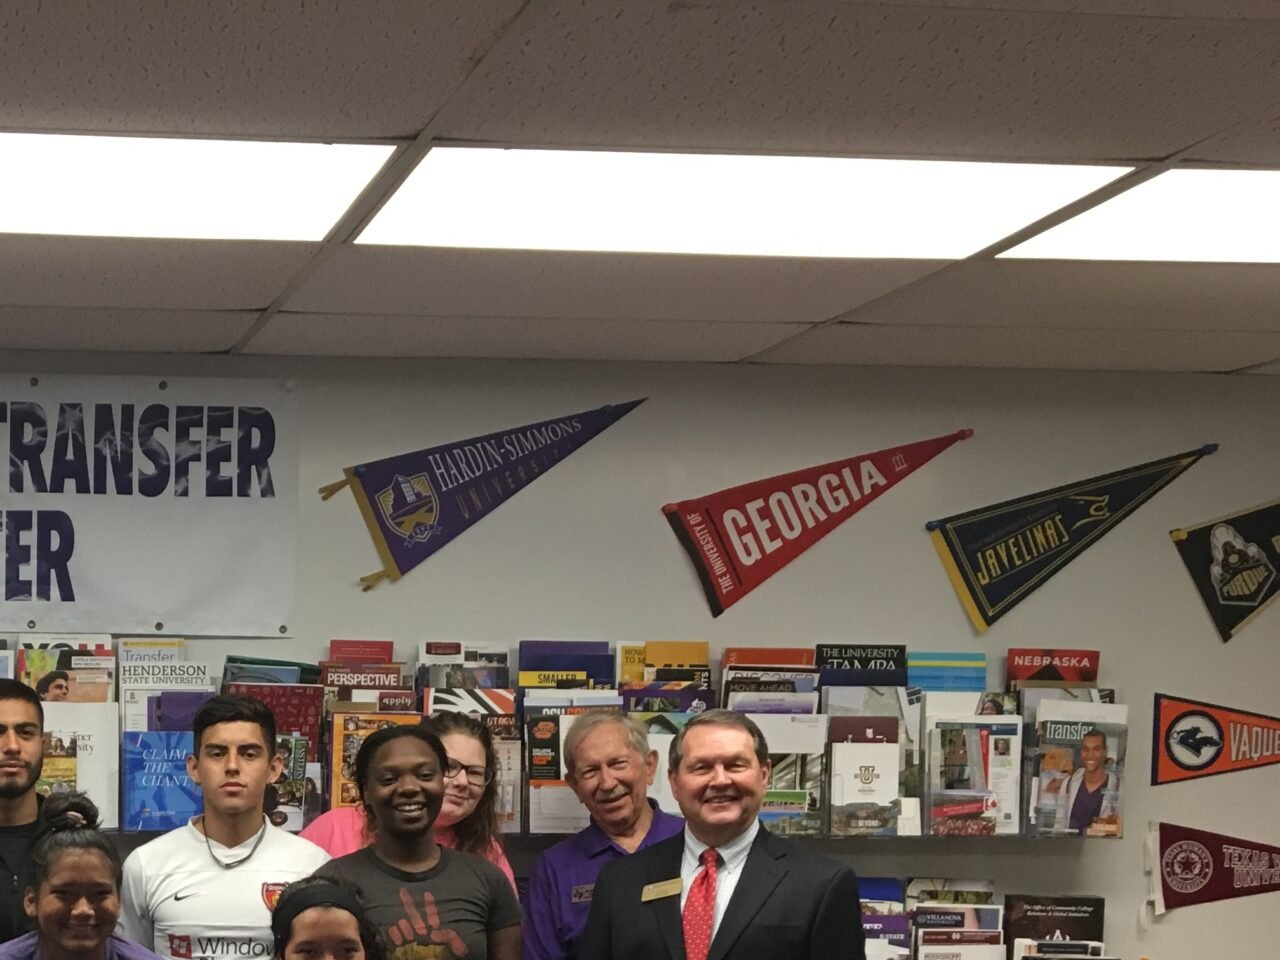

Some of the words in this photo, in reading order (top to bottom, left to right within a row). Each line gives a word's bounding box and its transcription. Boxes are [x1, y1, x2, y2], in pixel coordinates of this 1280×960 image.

[428, 418, 582, 491] HARDIN-SIMMONS
[686, 512, 701, 526] OF
[722, 459, 888, 566] GEORGIA
[695, 525, 726, 574] UNIVERSITY
[976, 514, 1069, 586] JAVELINAS
[722, 571, 735, 595] THE
[122, 649, 175, 662] Transfer
[822, 648, 841, 658] THE
[842, 648, 900, 658] UNIVERSITY
[1014, 655, 1090, 668] NEBRASKA
[121, 665, 207, 677] HENDERSON
[121, 677, 149, 685] STATE
[152, 677, 206, 685] UNIVERSITY
[327, 673, 398, 686] PERSPECTIVE
[729, 683, 758, 692] MOVE
[759, 683, 793, 692] AHEAD
[382, 696, 412, 706] apply
[1046, 721, 1094, 740] transfer
[142, 748, 187, 760] CLAIM
[142, 761, 170, 774] THE
[1222, 844, 1270, 869] TEXAS
